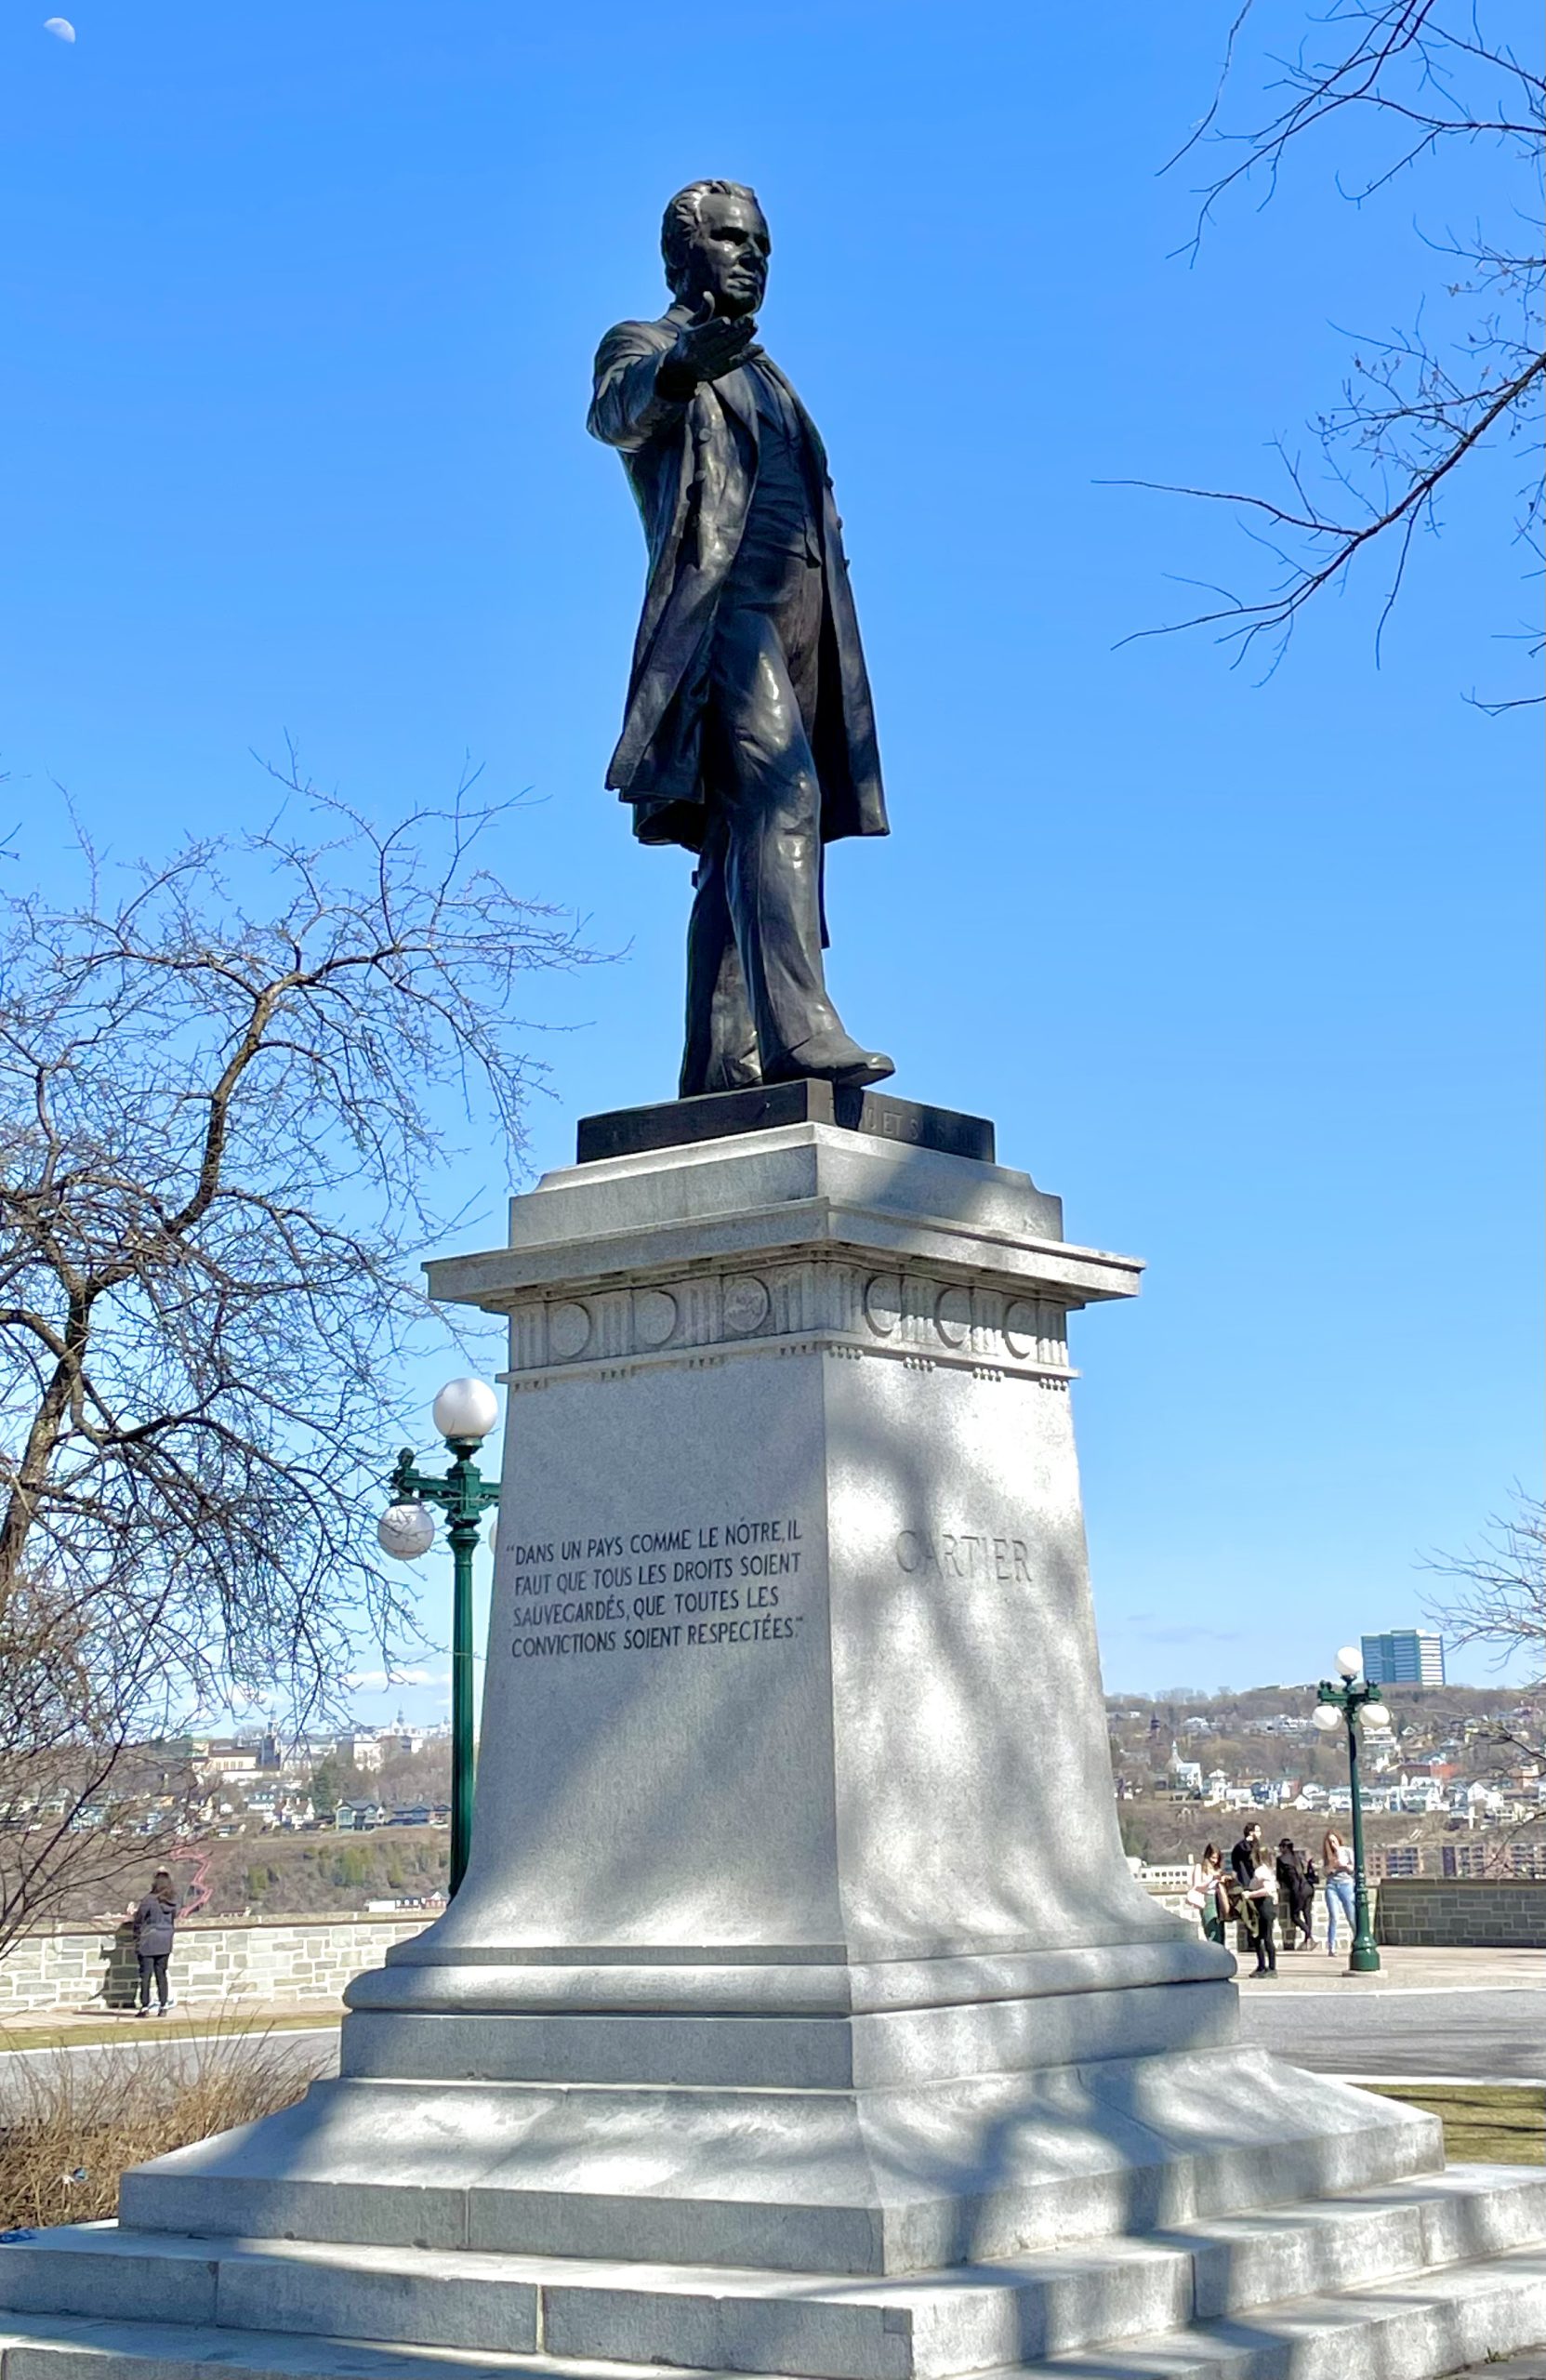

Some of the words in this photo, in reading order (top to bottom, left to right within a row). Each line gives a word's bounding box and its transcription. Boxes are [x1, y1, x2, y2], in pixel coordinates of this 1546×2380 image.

[562, 1540, 582, 1562] UN
[588, 1536, 624, 1559] PAYS
[630, 1529, 692, 1554] COMME
[699, 1526, 720, 1550] LE
[788, 1519, 802, 1541] IL
[896, 1529, 1033, 1582] CARTIER
[515, 1574, 552, 1596] FAUT
[557, 1570, 587, 1594] QUE
[593, 1566, 632, 1590] TOUS
[638, 1563, 667, 1586] LES
[674, 1557, 733, 1582] DROITS
[740, 1552, 802, 1577] SOIENT
[513, 1593, 630, 1627] SAUVEGARDÉS,
[633, 1594, 667, 1620] QUE
[674, 1589, 740, 1615] TOUTES
[747, 1586, 779, 1609] LES
[511, 1631, 616, 1658] CONVICTIONS
[623, 1626, 681, 1651] SOIENT
